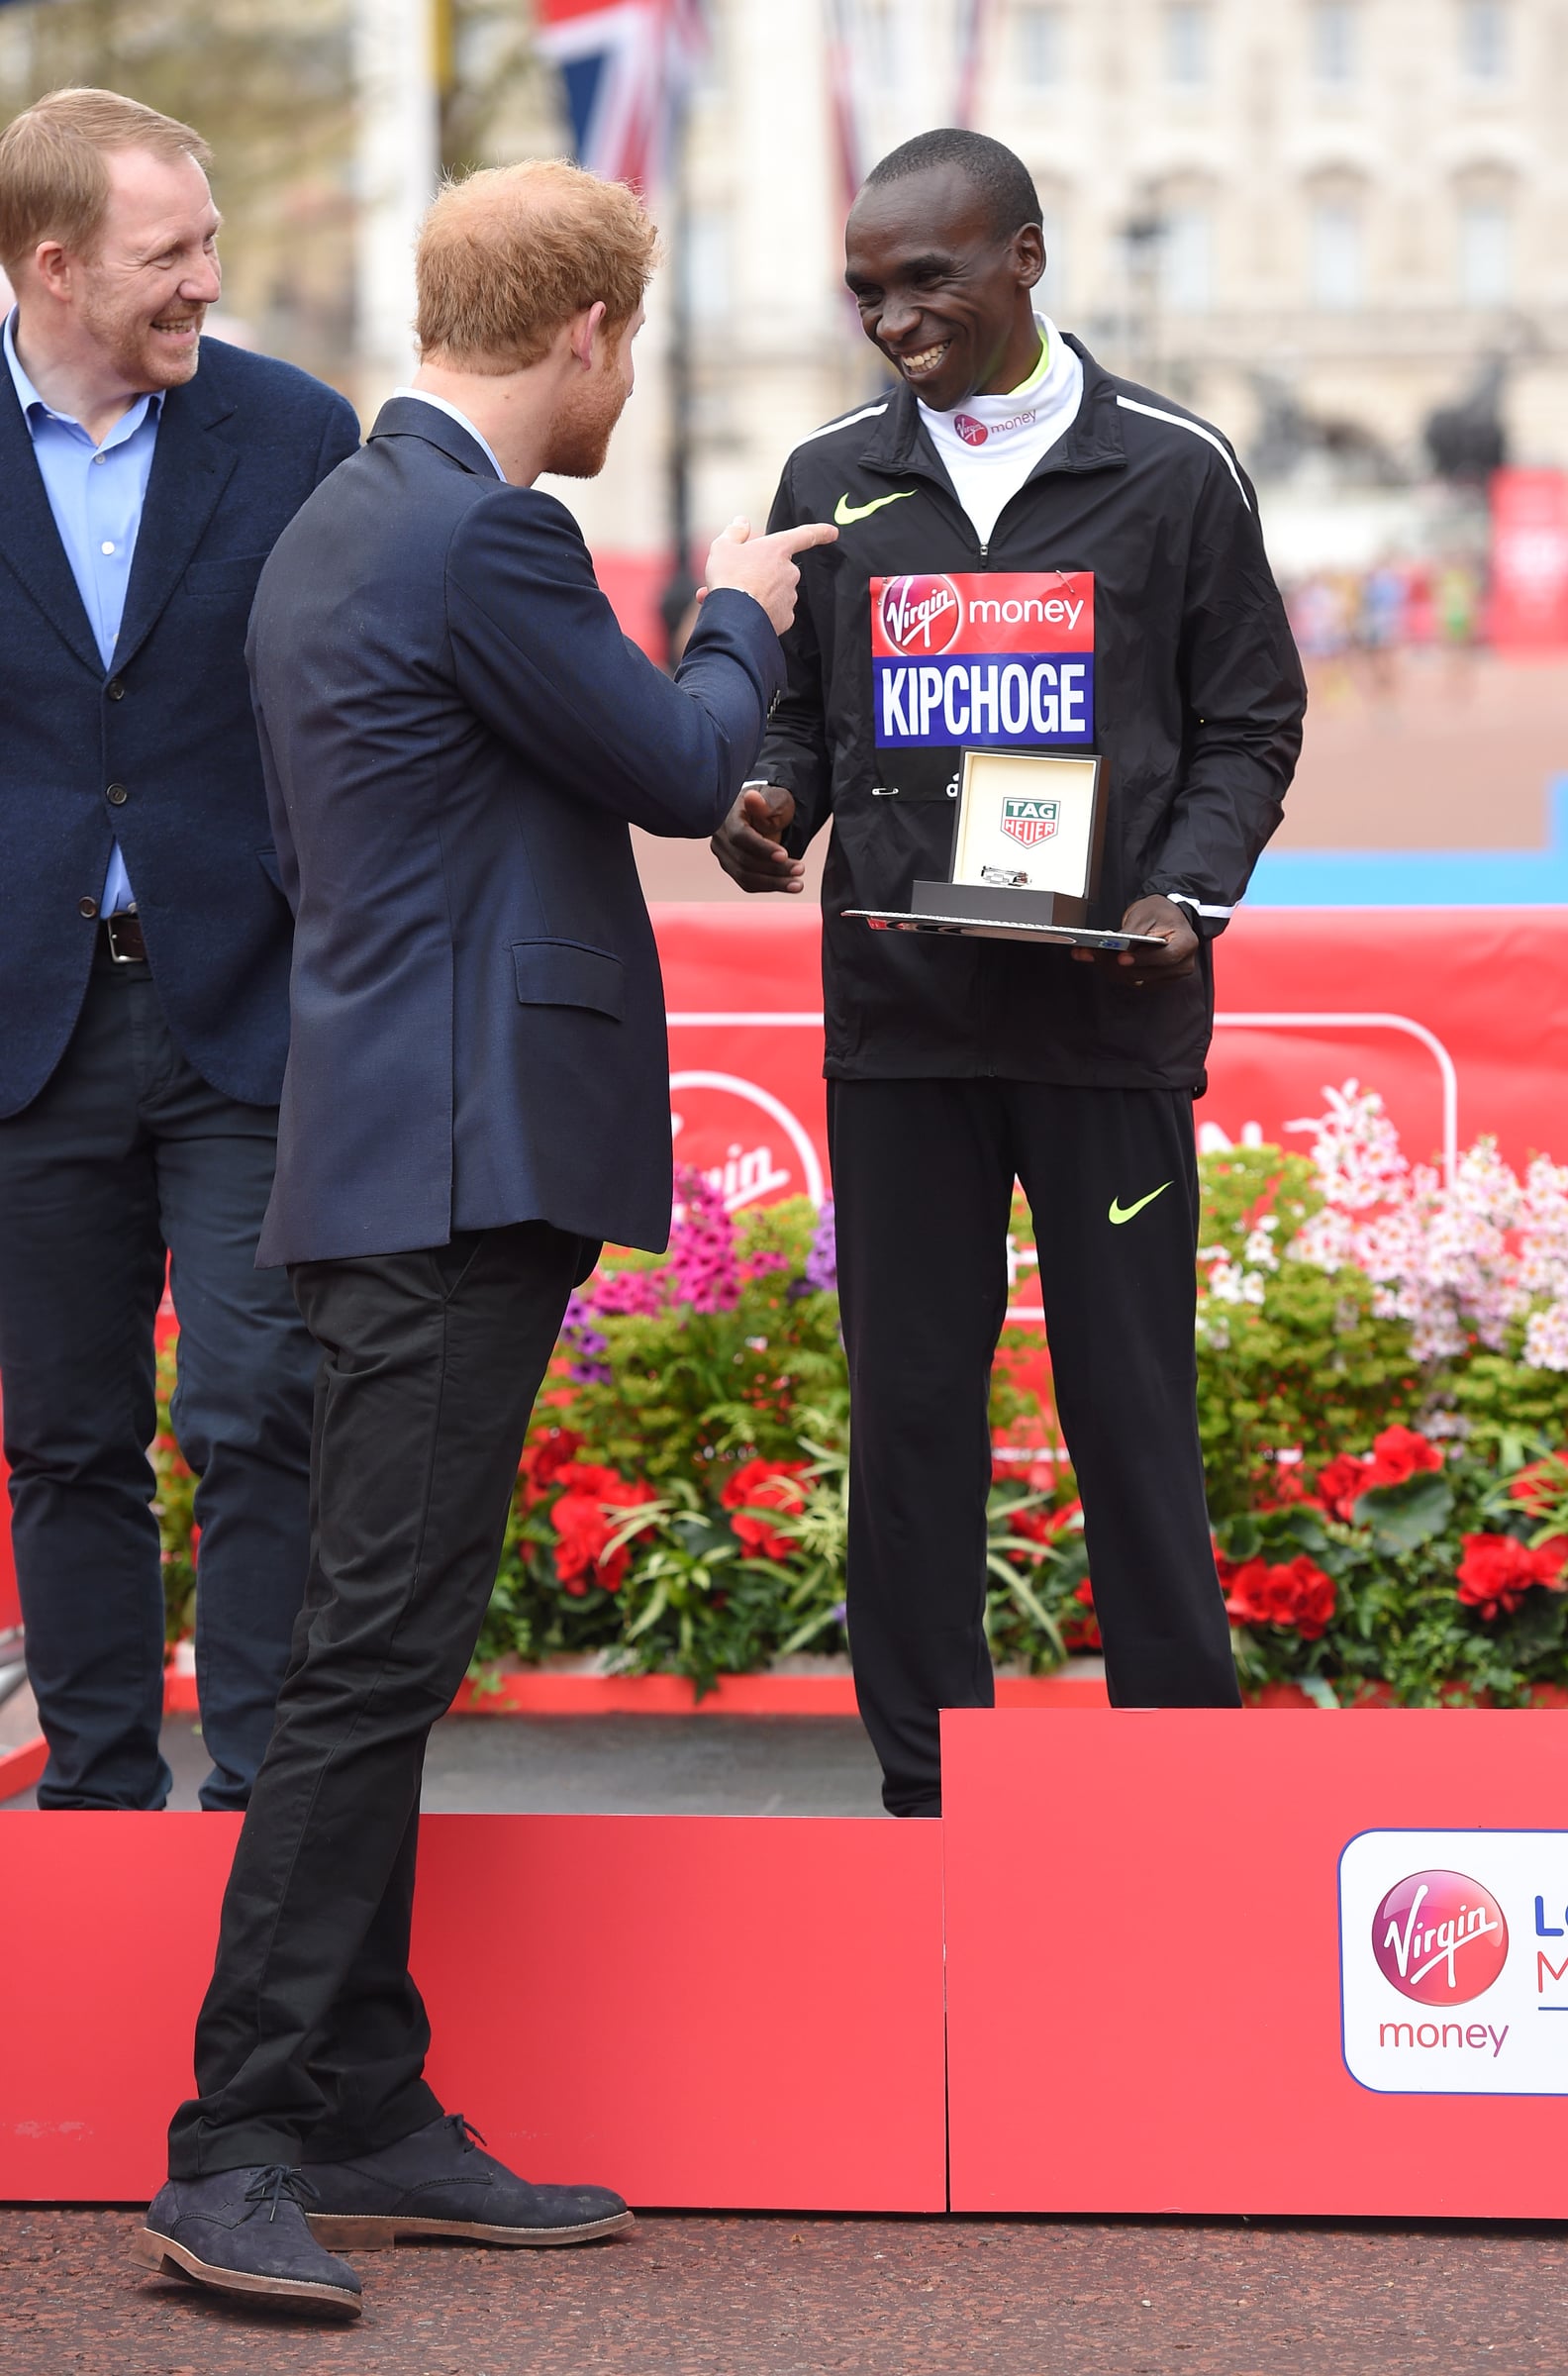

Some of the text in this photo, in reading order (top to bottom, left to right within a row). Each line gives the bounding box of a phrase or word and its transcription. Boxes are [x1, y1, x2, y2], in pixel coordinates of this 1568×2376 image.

[956, 409, 1037, 443] Virgin money
[886, 576, 1084, 647] Virgin money
[881, 663, 1086, 737] KIPCHOGE
[1007, 801, 1055, 819] TAG
[1004, 820, 1055, 845] HEUER
[1534, 1895, 1568, 1937] L
[1383, 1884, 1500, 1988] Virgin
[1379, 2023, 1510, 2058] money
